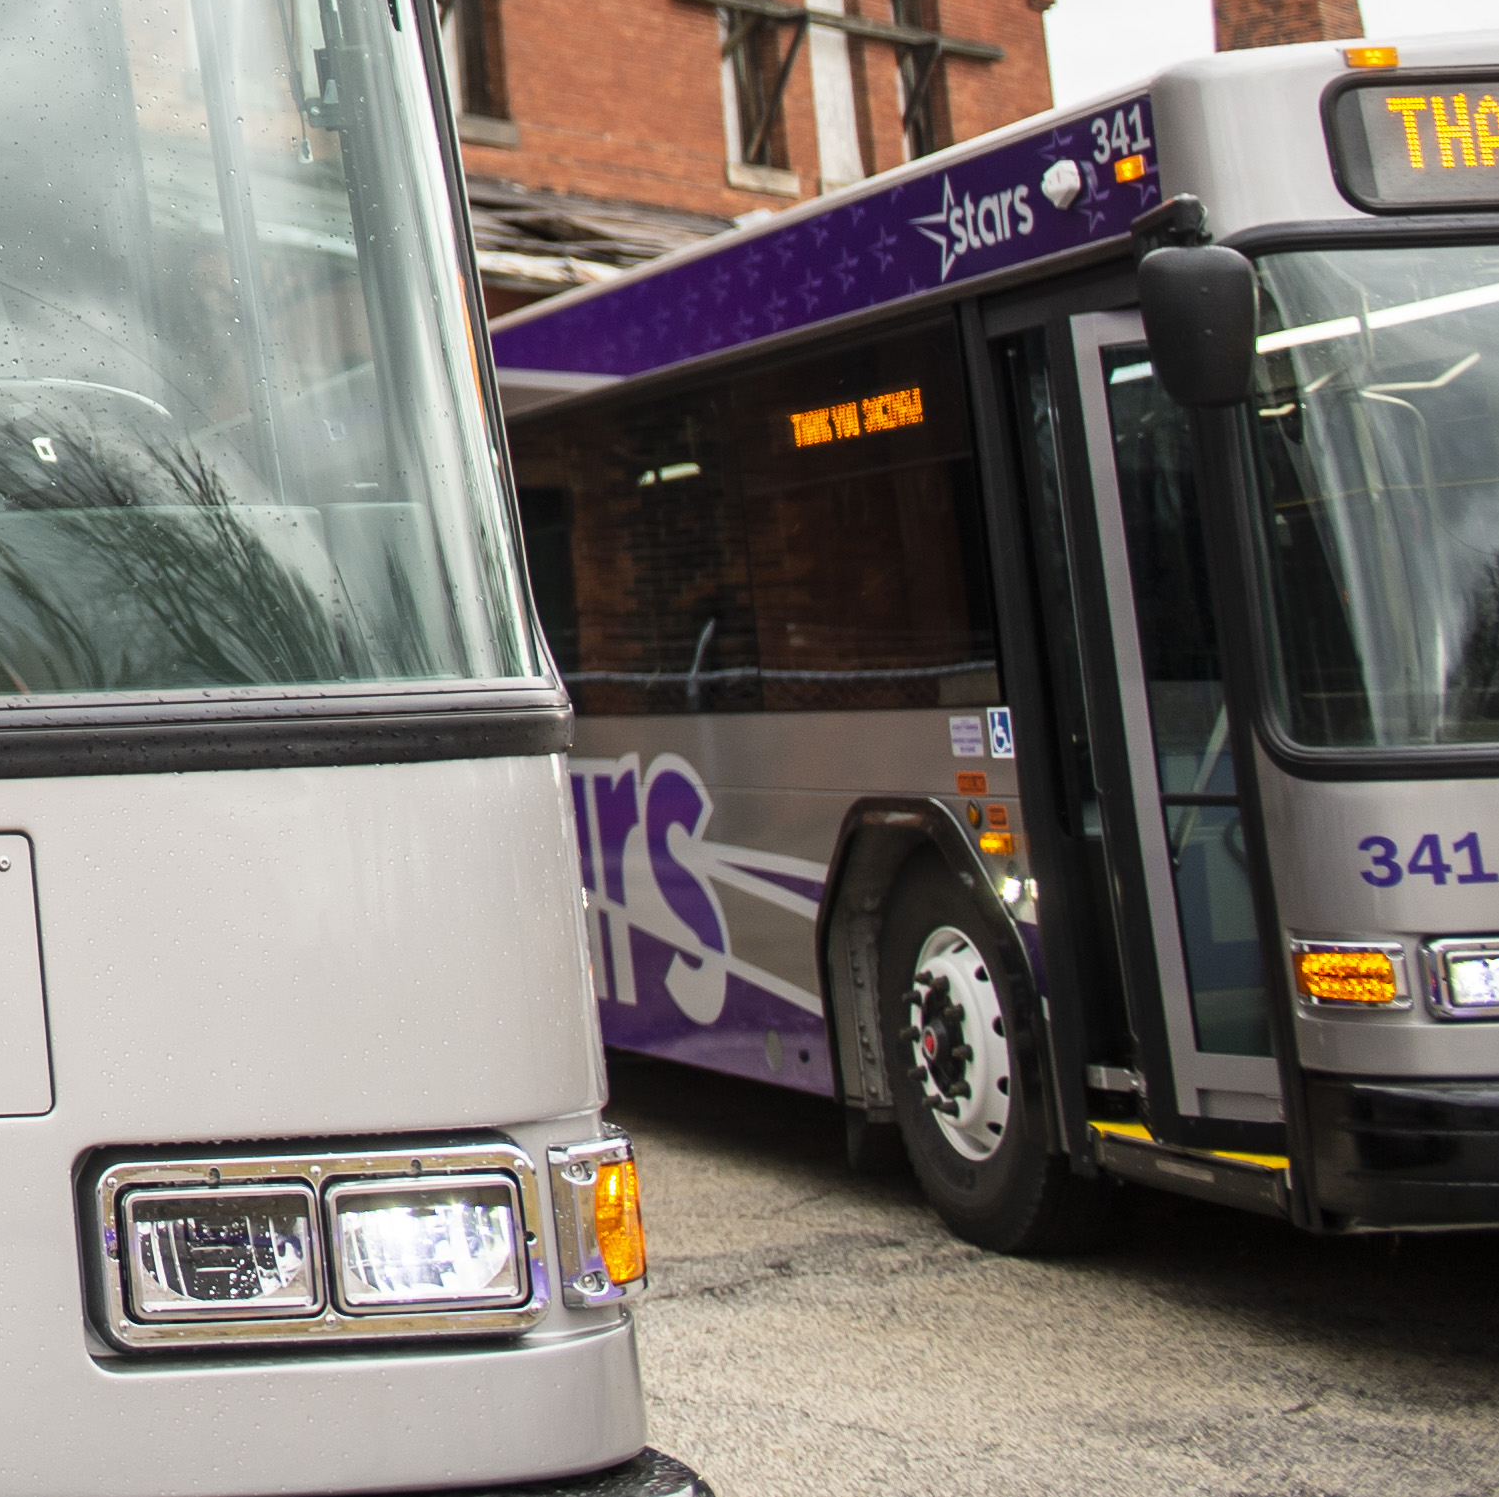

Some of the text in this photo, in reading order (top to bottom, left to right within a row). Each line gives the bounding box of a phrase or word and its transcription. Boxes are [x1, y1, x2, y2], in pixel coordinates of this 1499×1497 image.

[1091, 103, 1151, 165] 341
[949, 184, 1034, 255] stars
[1357, 832, 1499, 888] 341
